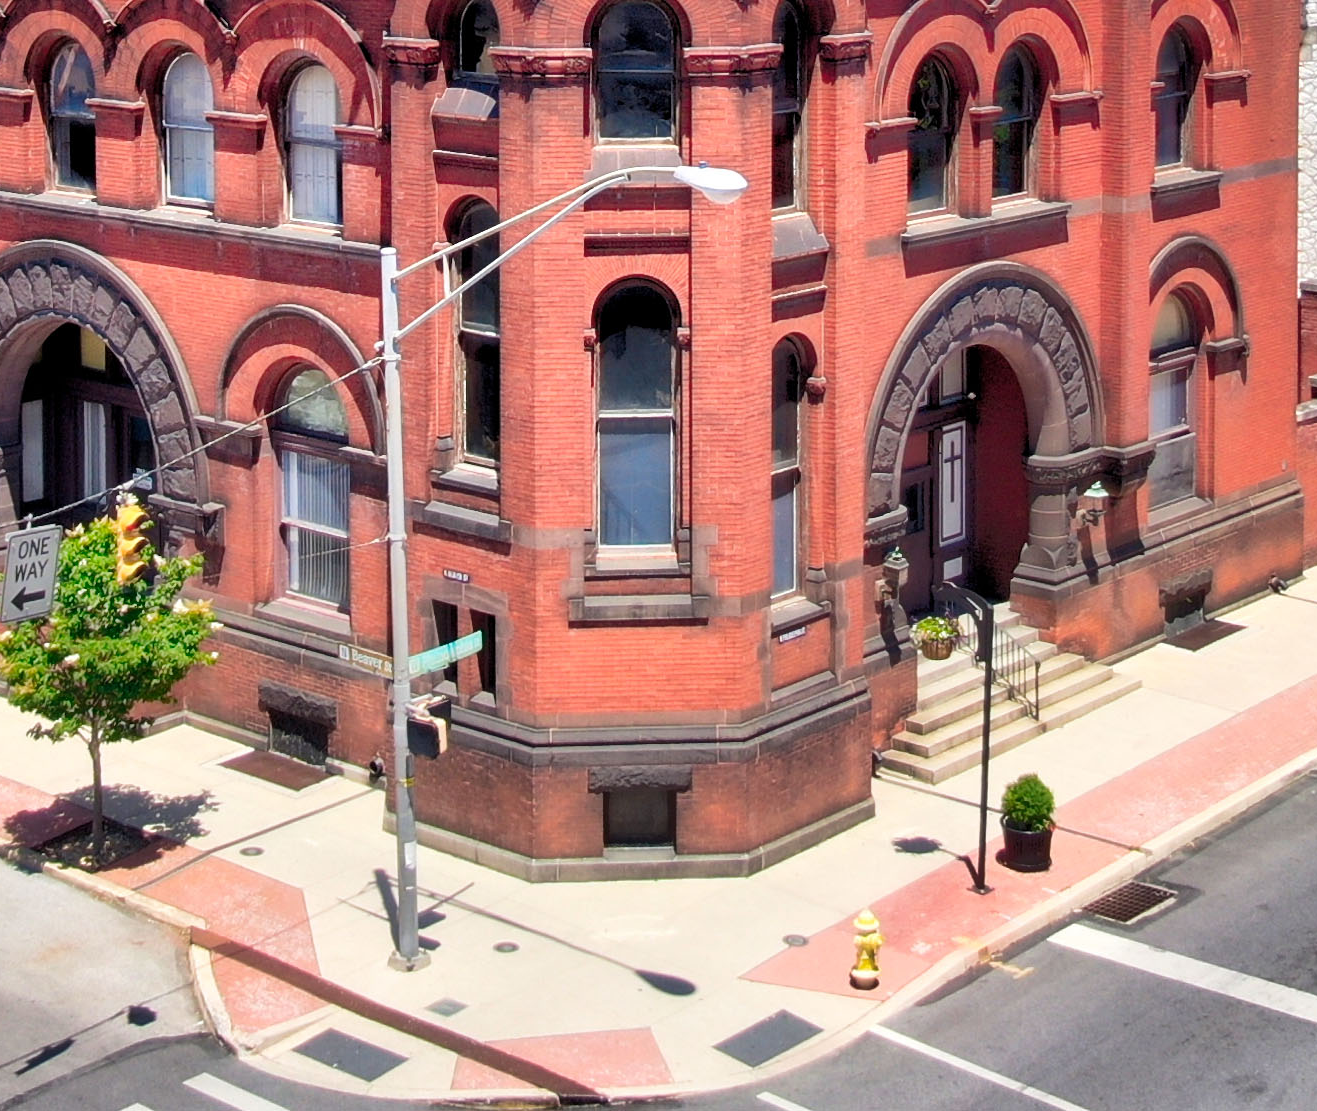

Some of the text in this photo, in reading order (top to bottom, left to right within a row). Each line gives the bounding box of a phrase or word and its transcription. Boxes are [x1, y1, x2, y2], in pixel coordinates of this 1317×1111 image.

[18, 536, 51, 559] ONE
[15, 559, 49, 583] WAY
[351, 648, 383, 670] Beaver
